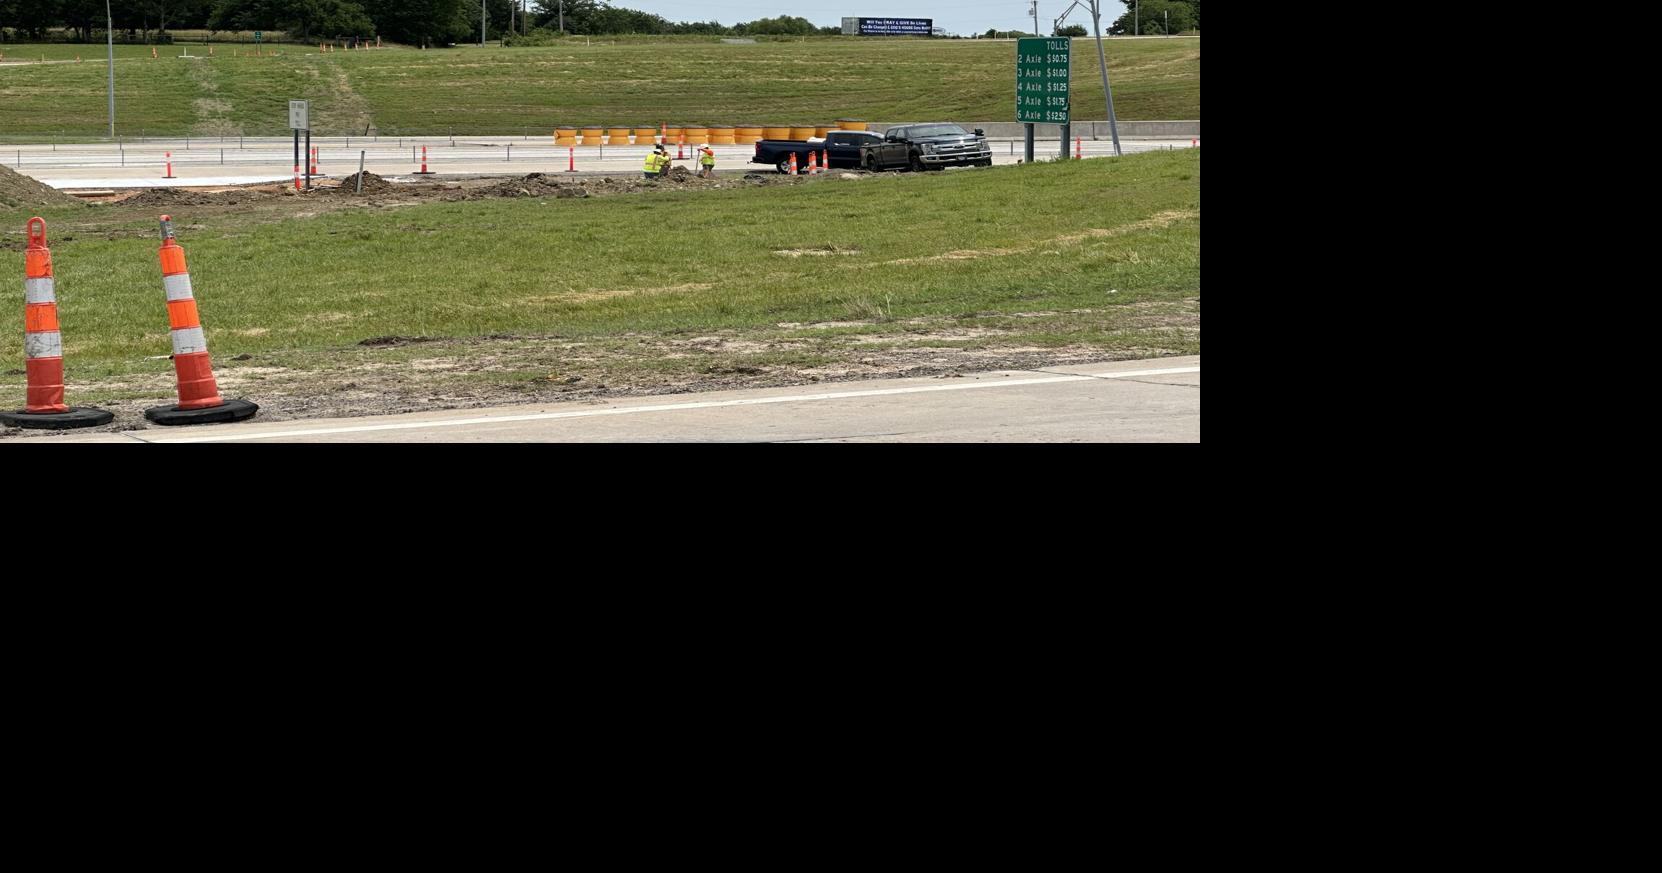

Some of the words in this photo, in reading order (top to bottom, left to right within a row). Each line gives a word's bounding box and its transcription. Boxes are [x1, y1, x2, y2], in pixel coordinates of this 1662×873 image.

[1046, 41, 1068, 50] TOLLS
[1018, 54, 1022, 63] 2
[1026, 54, 1041, 63] Axle
[1047, 54, 1051, 63] $
[1018, 68, 1022, 77] 3
[1025, 68, 1041, 77] Axle
[1047, 68, 1051, 78] $
[1018, 82, 1022, 91] 4
[1026, 82, 1042, 91] Axle
[1047, 82, 1051, 92] $
[1018, 96, 1022, 104] 5
[1025, 96, 1041, 106] Axle
[1047, 96, 1051, 106] $
[1017, 110, 1022, 119] 6
[1025, 110, 1041, 119] Axle
[1046, 111, 1050, 120] $
